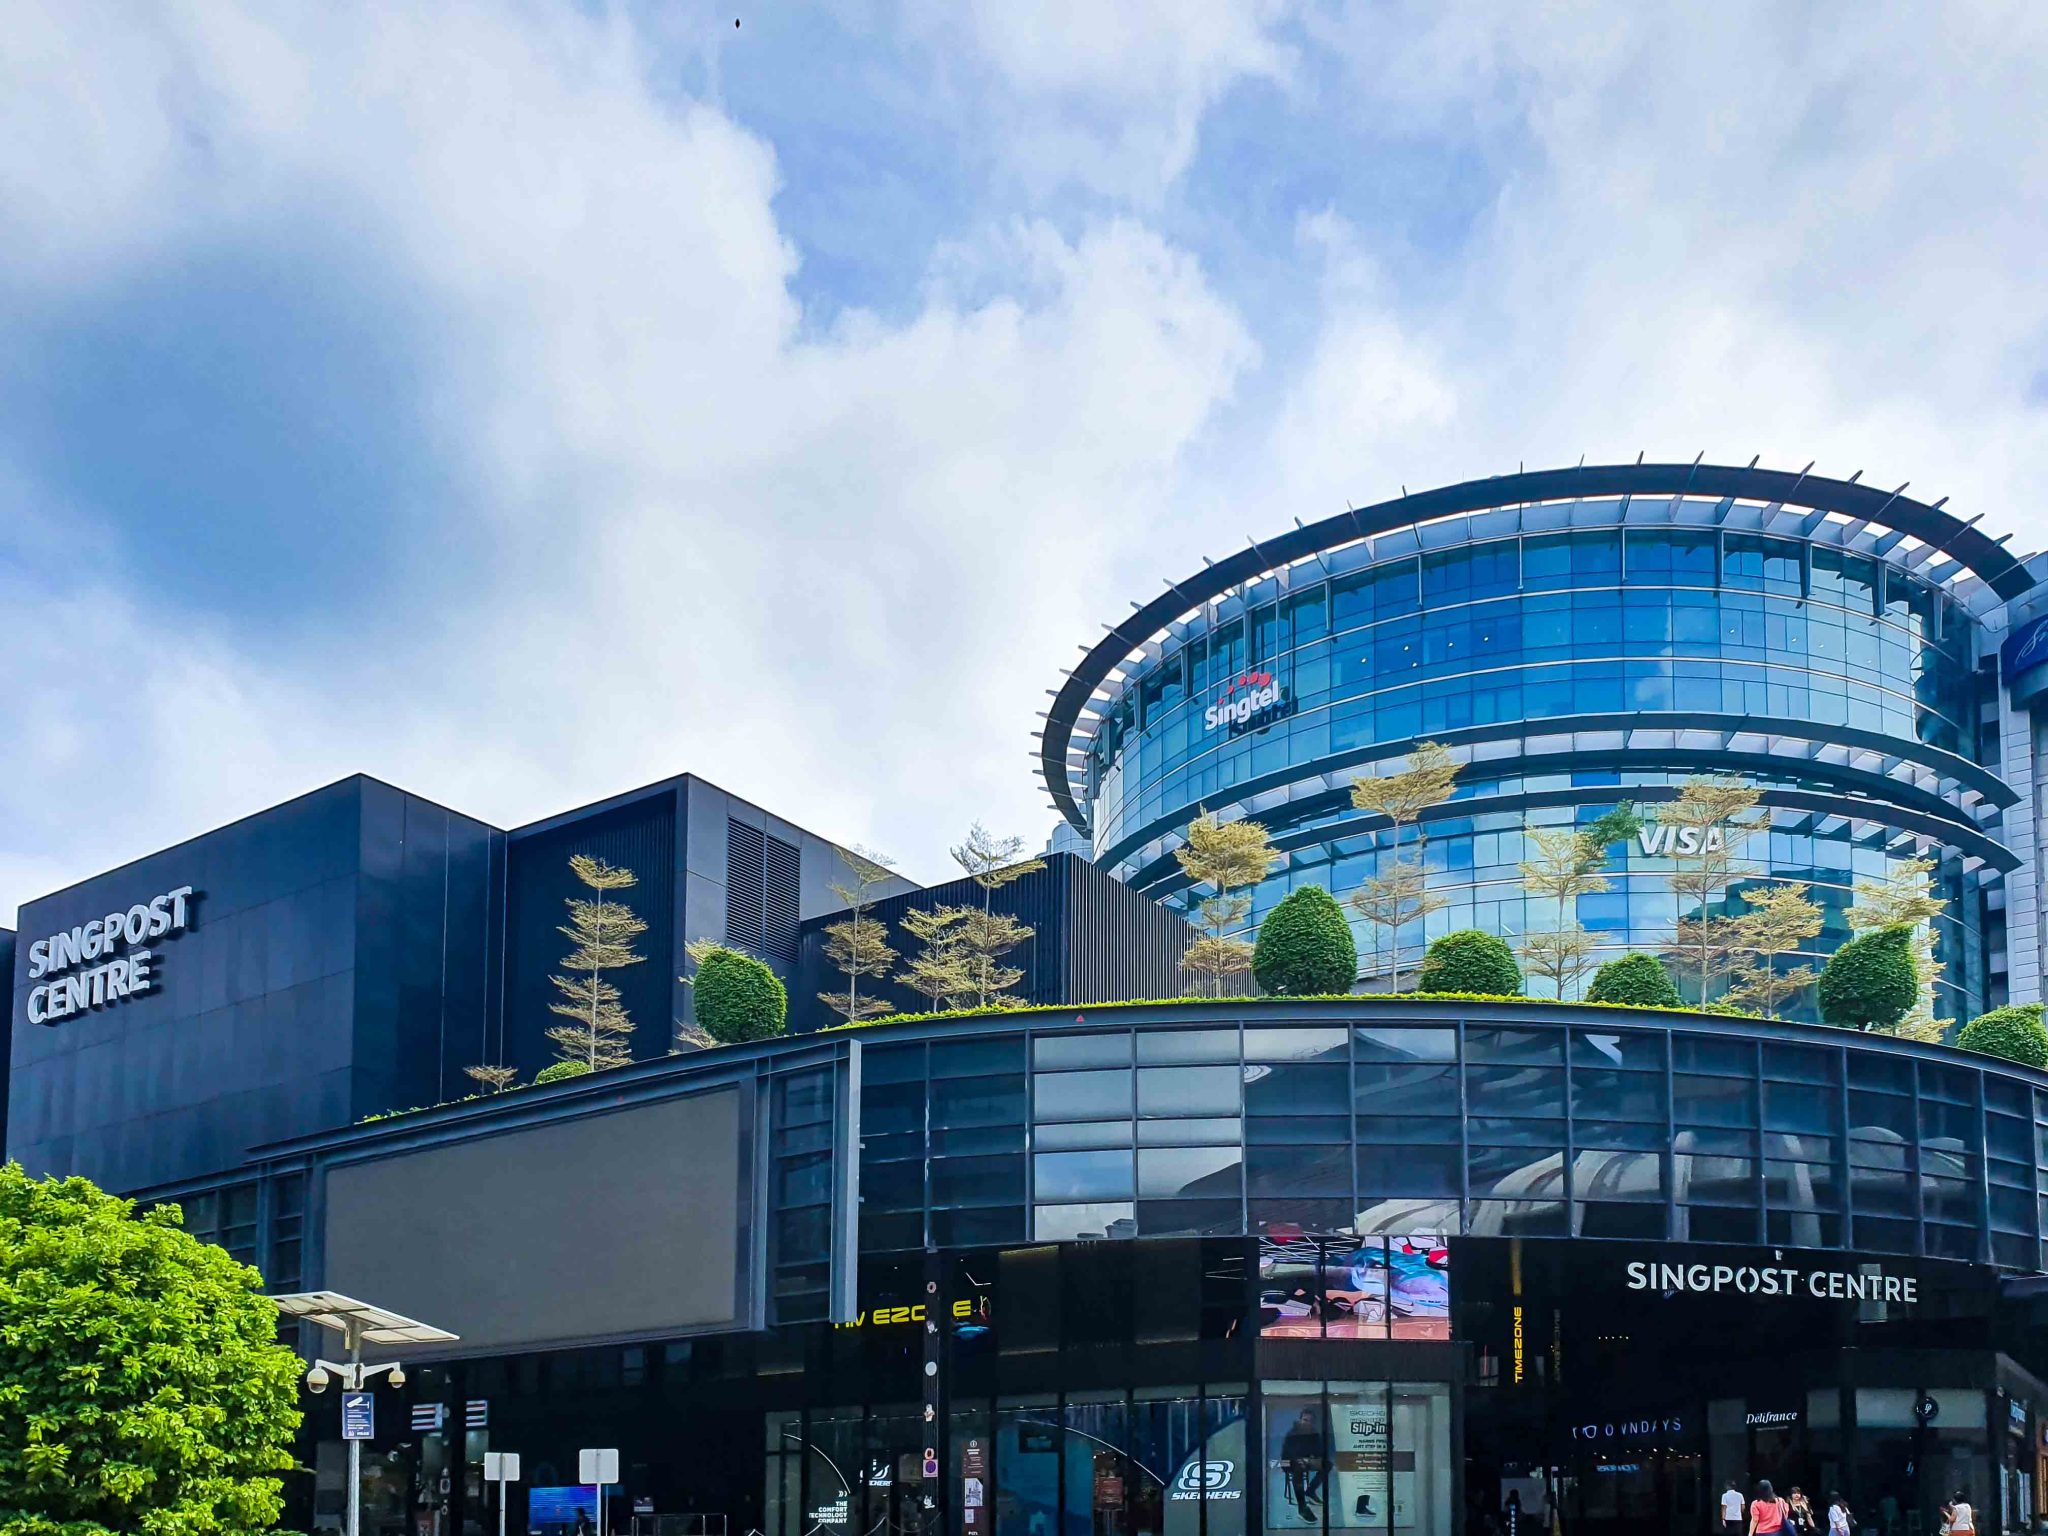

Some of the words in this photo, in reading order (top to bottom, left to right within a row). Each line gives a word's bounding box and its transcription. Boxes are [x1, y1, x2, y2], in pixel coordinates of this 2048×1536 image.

[1205, 680, 1279, 731] Singtel
[1638, 826, 1725, 856] VISA
[28, 886, 193, 980] SINGPOST
[27, 950, 153, 1025] CENTRE
[1627, 1262, 1798, 1295] SINGPOST
[1809, 1270, 1917, 1303] CENTRE
[1513, 1306, 1524, 1384] TIMEZONE
[1351, 1422, 1387, 1435] Slip-in
